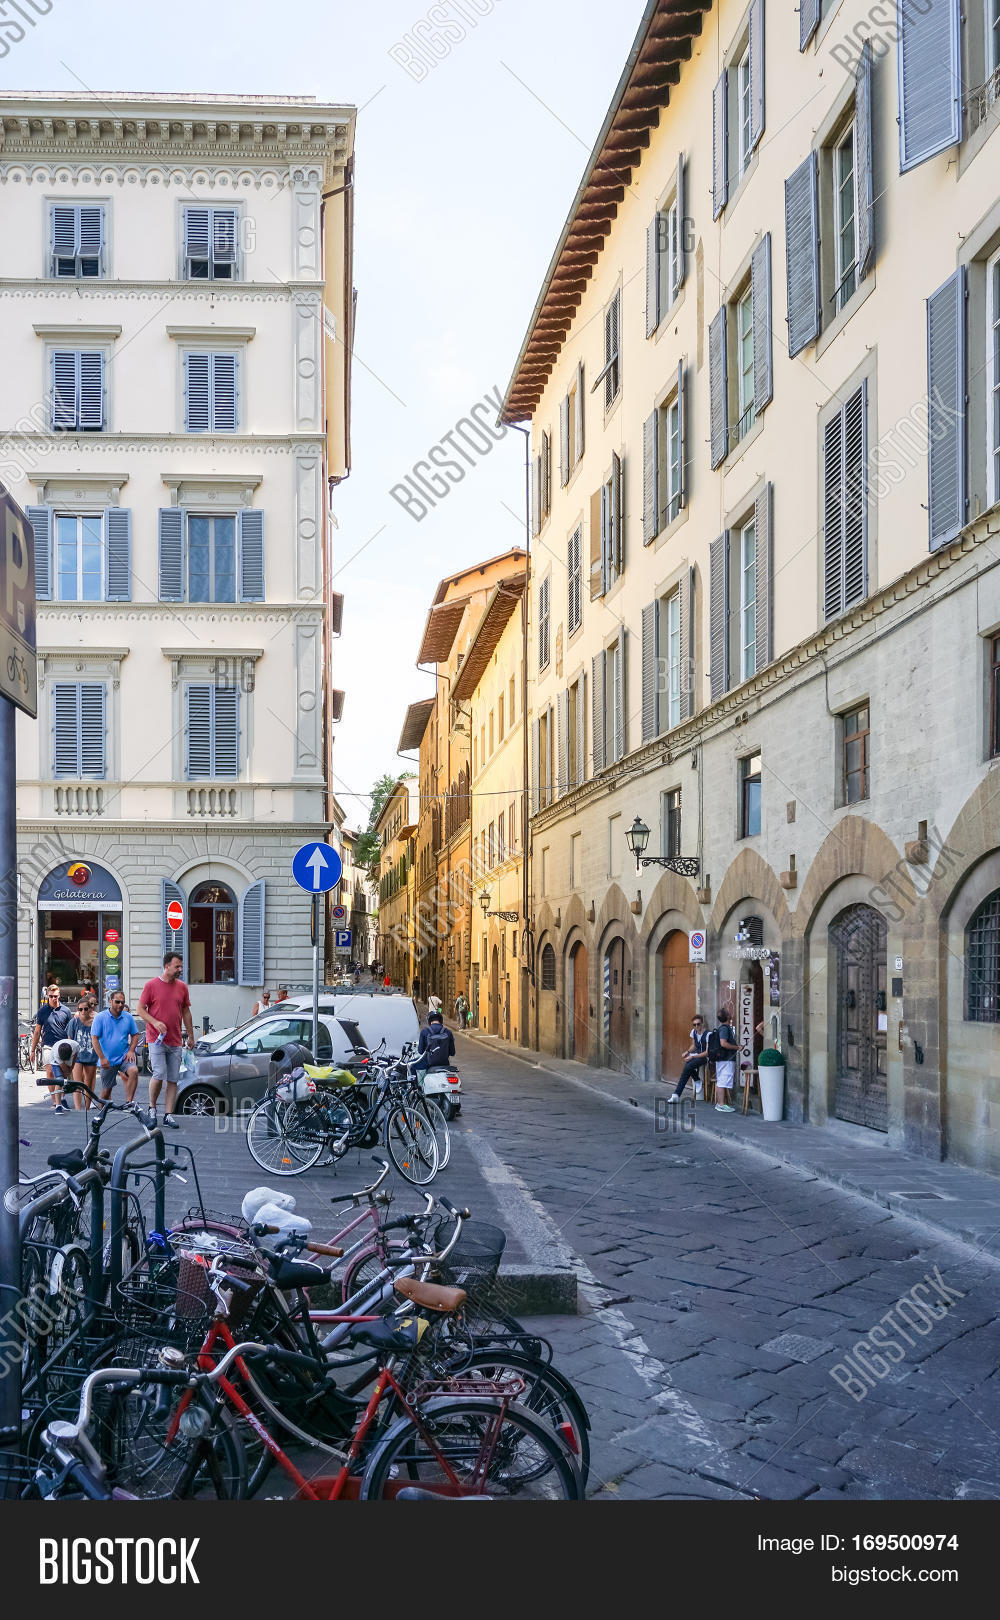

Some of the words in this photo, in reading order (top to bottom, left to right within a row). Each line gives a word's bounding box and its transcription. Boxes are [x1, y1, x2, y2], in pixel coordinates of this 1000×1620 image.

[6, 504, 28, 616] P
[53, 888, 107, 900] Gelateria
[338, 933, 349, 946] P
[743, 997, 751, 1058] GELATO
